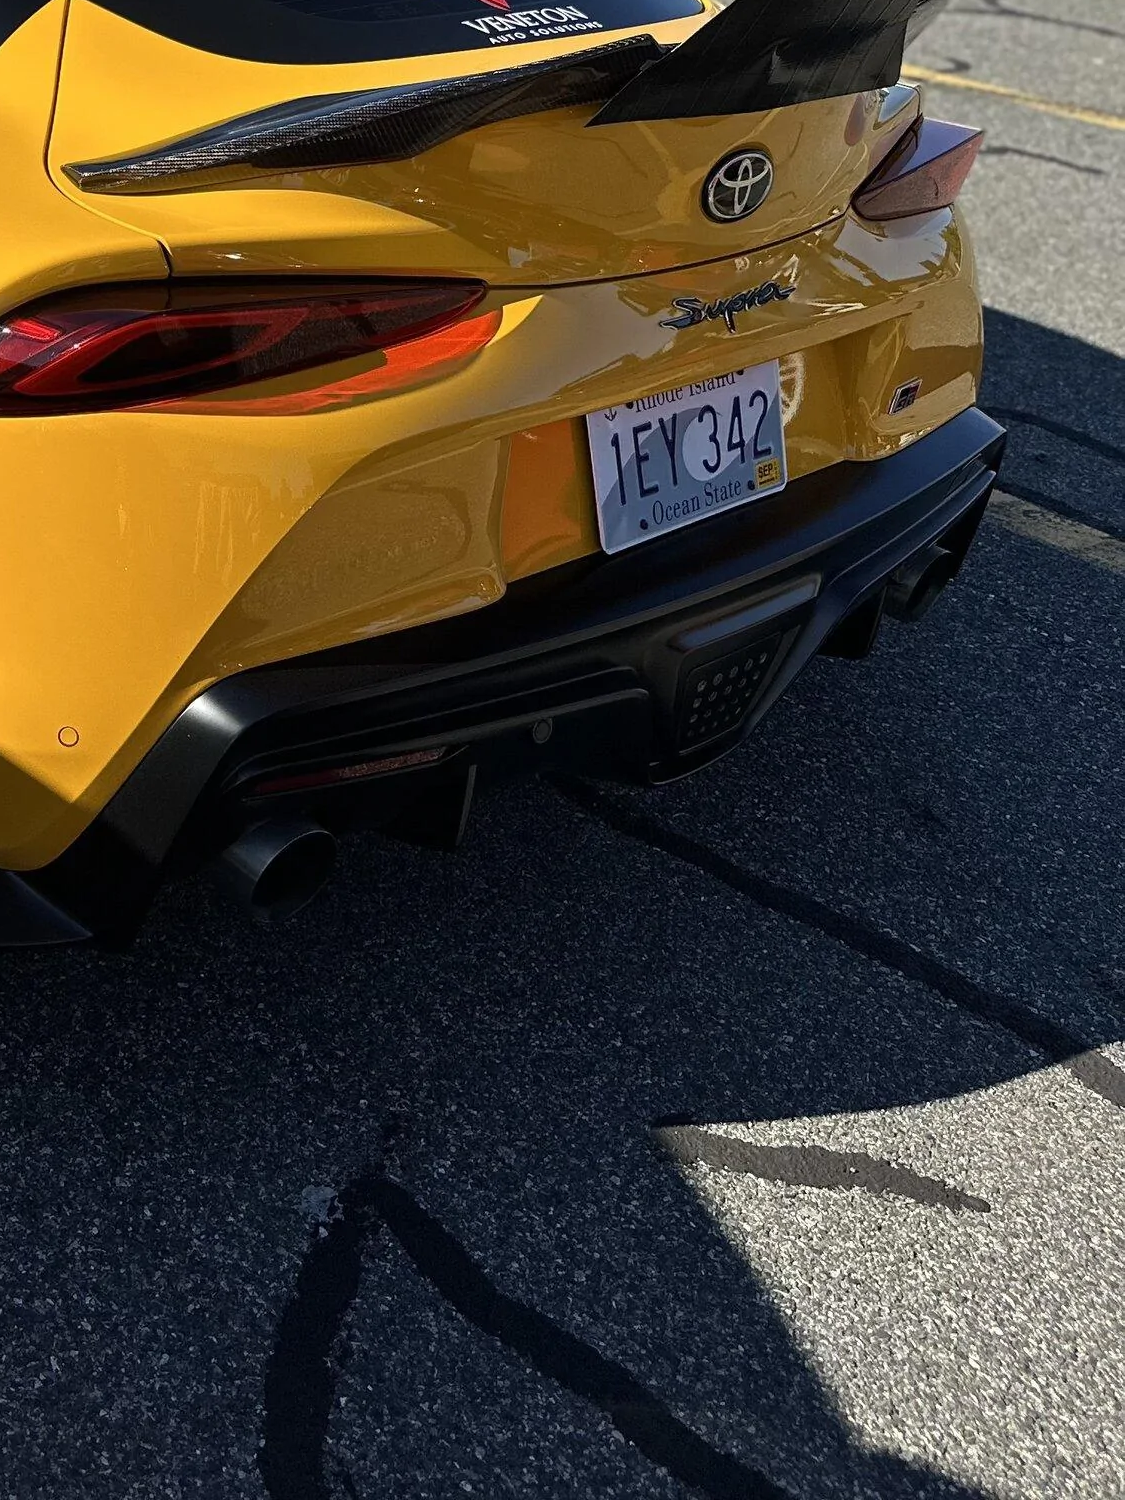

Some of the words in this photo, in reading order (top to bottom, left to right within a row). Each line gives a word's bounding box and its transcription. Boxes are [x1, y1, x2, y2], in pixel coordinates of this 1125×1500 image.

[461, 5, 589, 34] VENETON
[489, 31, 527, 45] AUTO
[529, 21, 604, 38] SOLUTIONS
[658, 280, 797, 333] Supra
[611, 413, 679, 506] 1EY
[698, 389, 772, 474] 342
[758, 463, 774, 479] SEP
[652, 501, 701, 525] Ocean
[703, 479, 743, 508] State
